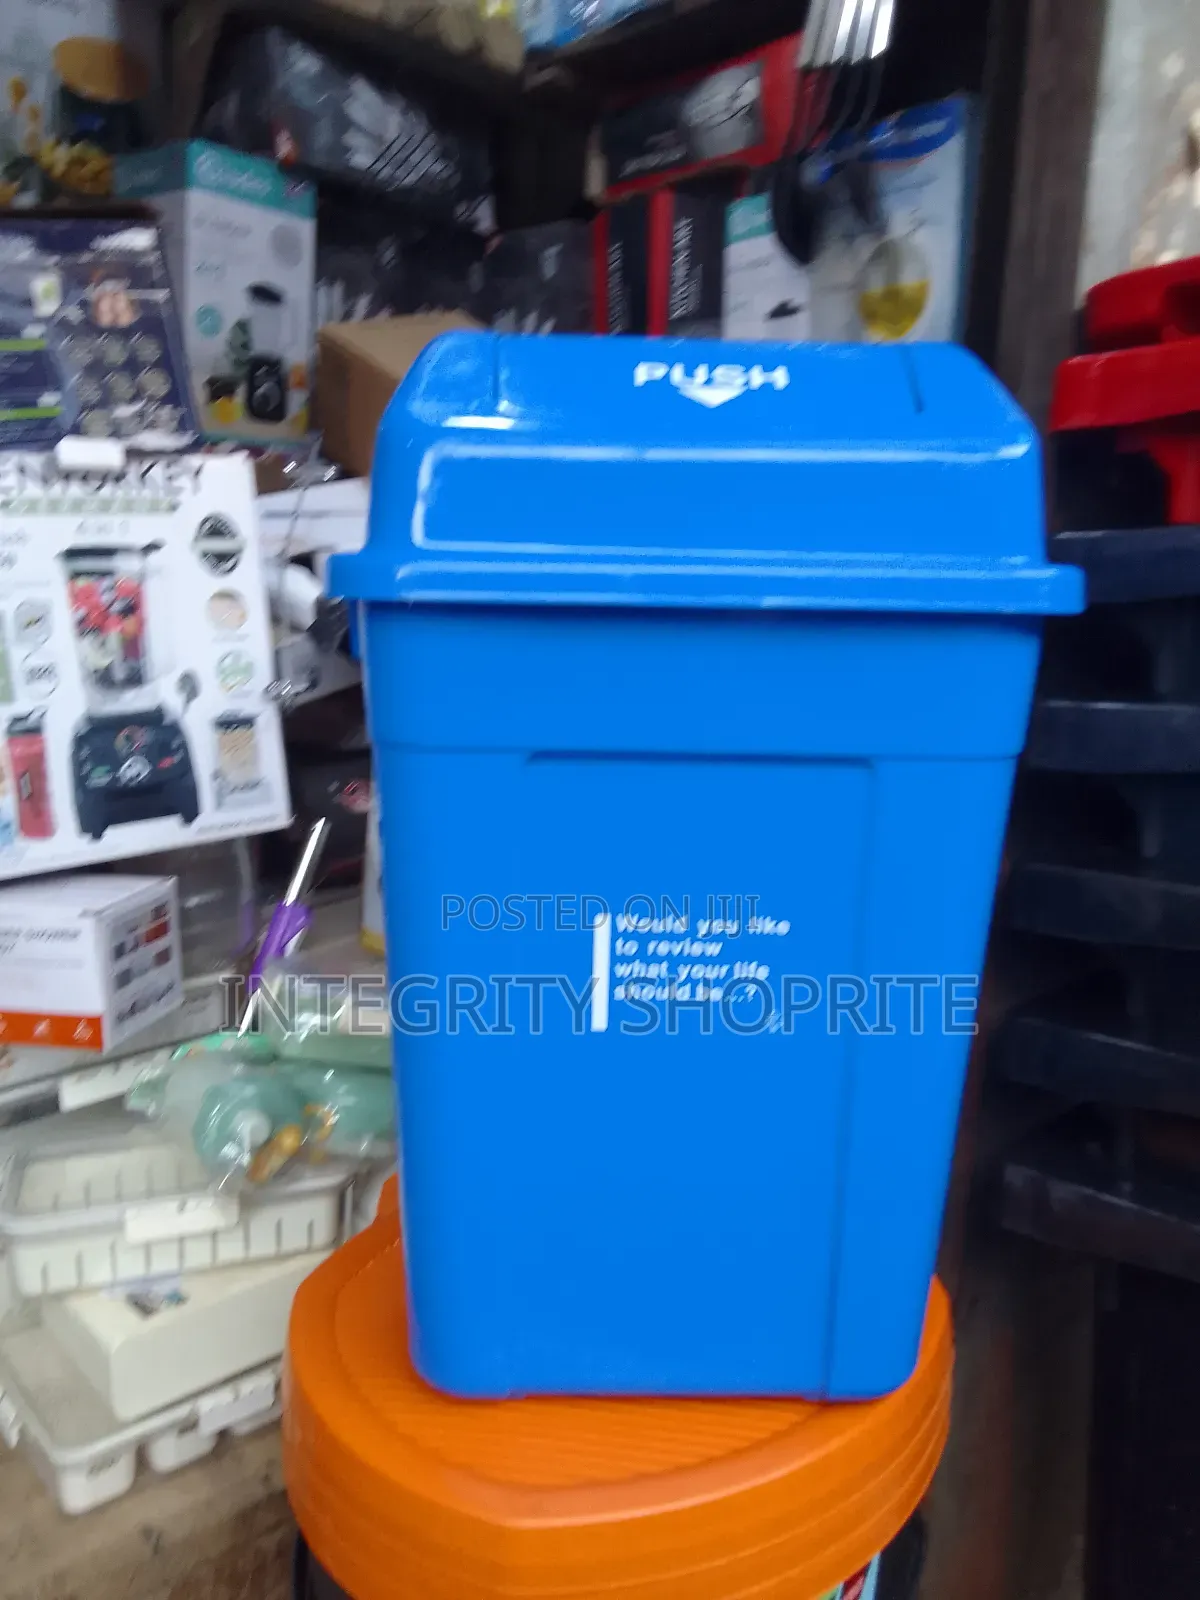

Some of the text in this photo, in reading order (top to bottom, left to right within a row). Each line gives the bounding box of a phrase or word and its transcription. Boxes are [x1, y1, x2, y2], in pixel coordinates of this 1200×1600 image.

[633, 361, 790, 391] PUSH
[615, 913, 791, 938] Would you like
[615, 937, 723, 957] to review
[614, 959, 770, 984] what your life
[613, 982, 691, 1001] should
